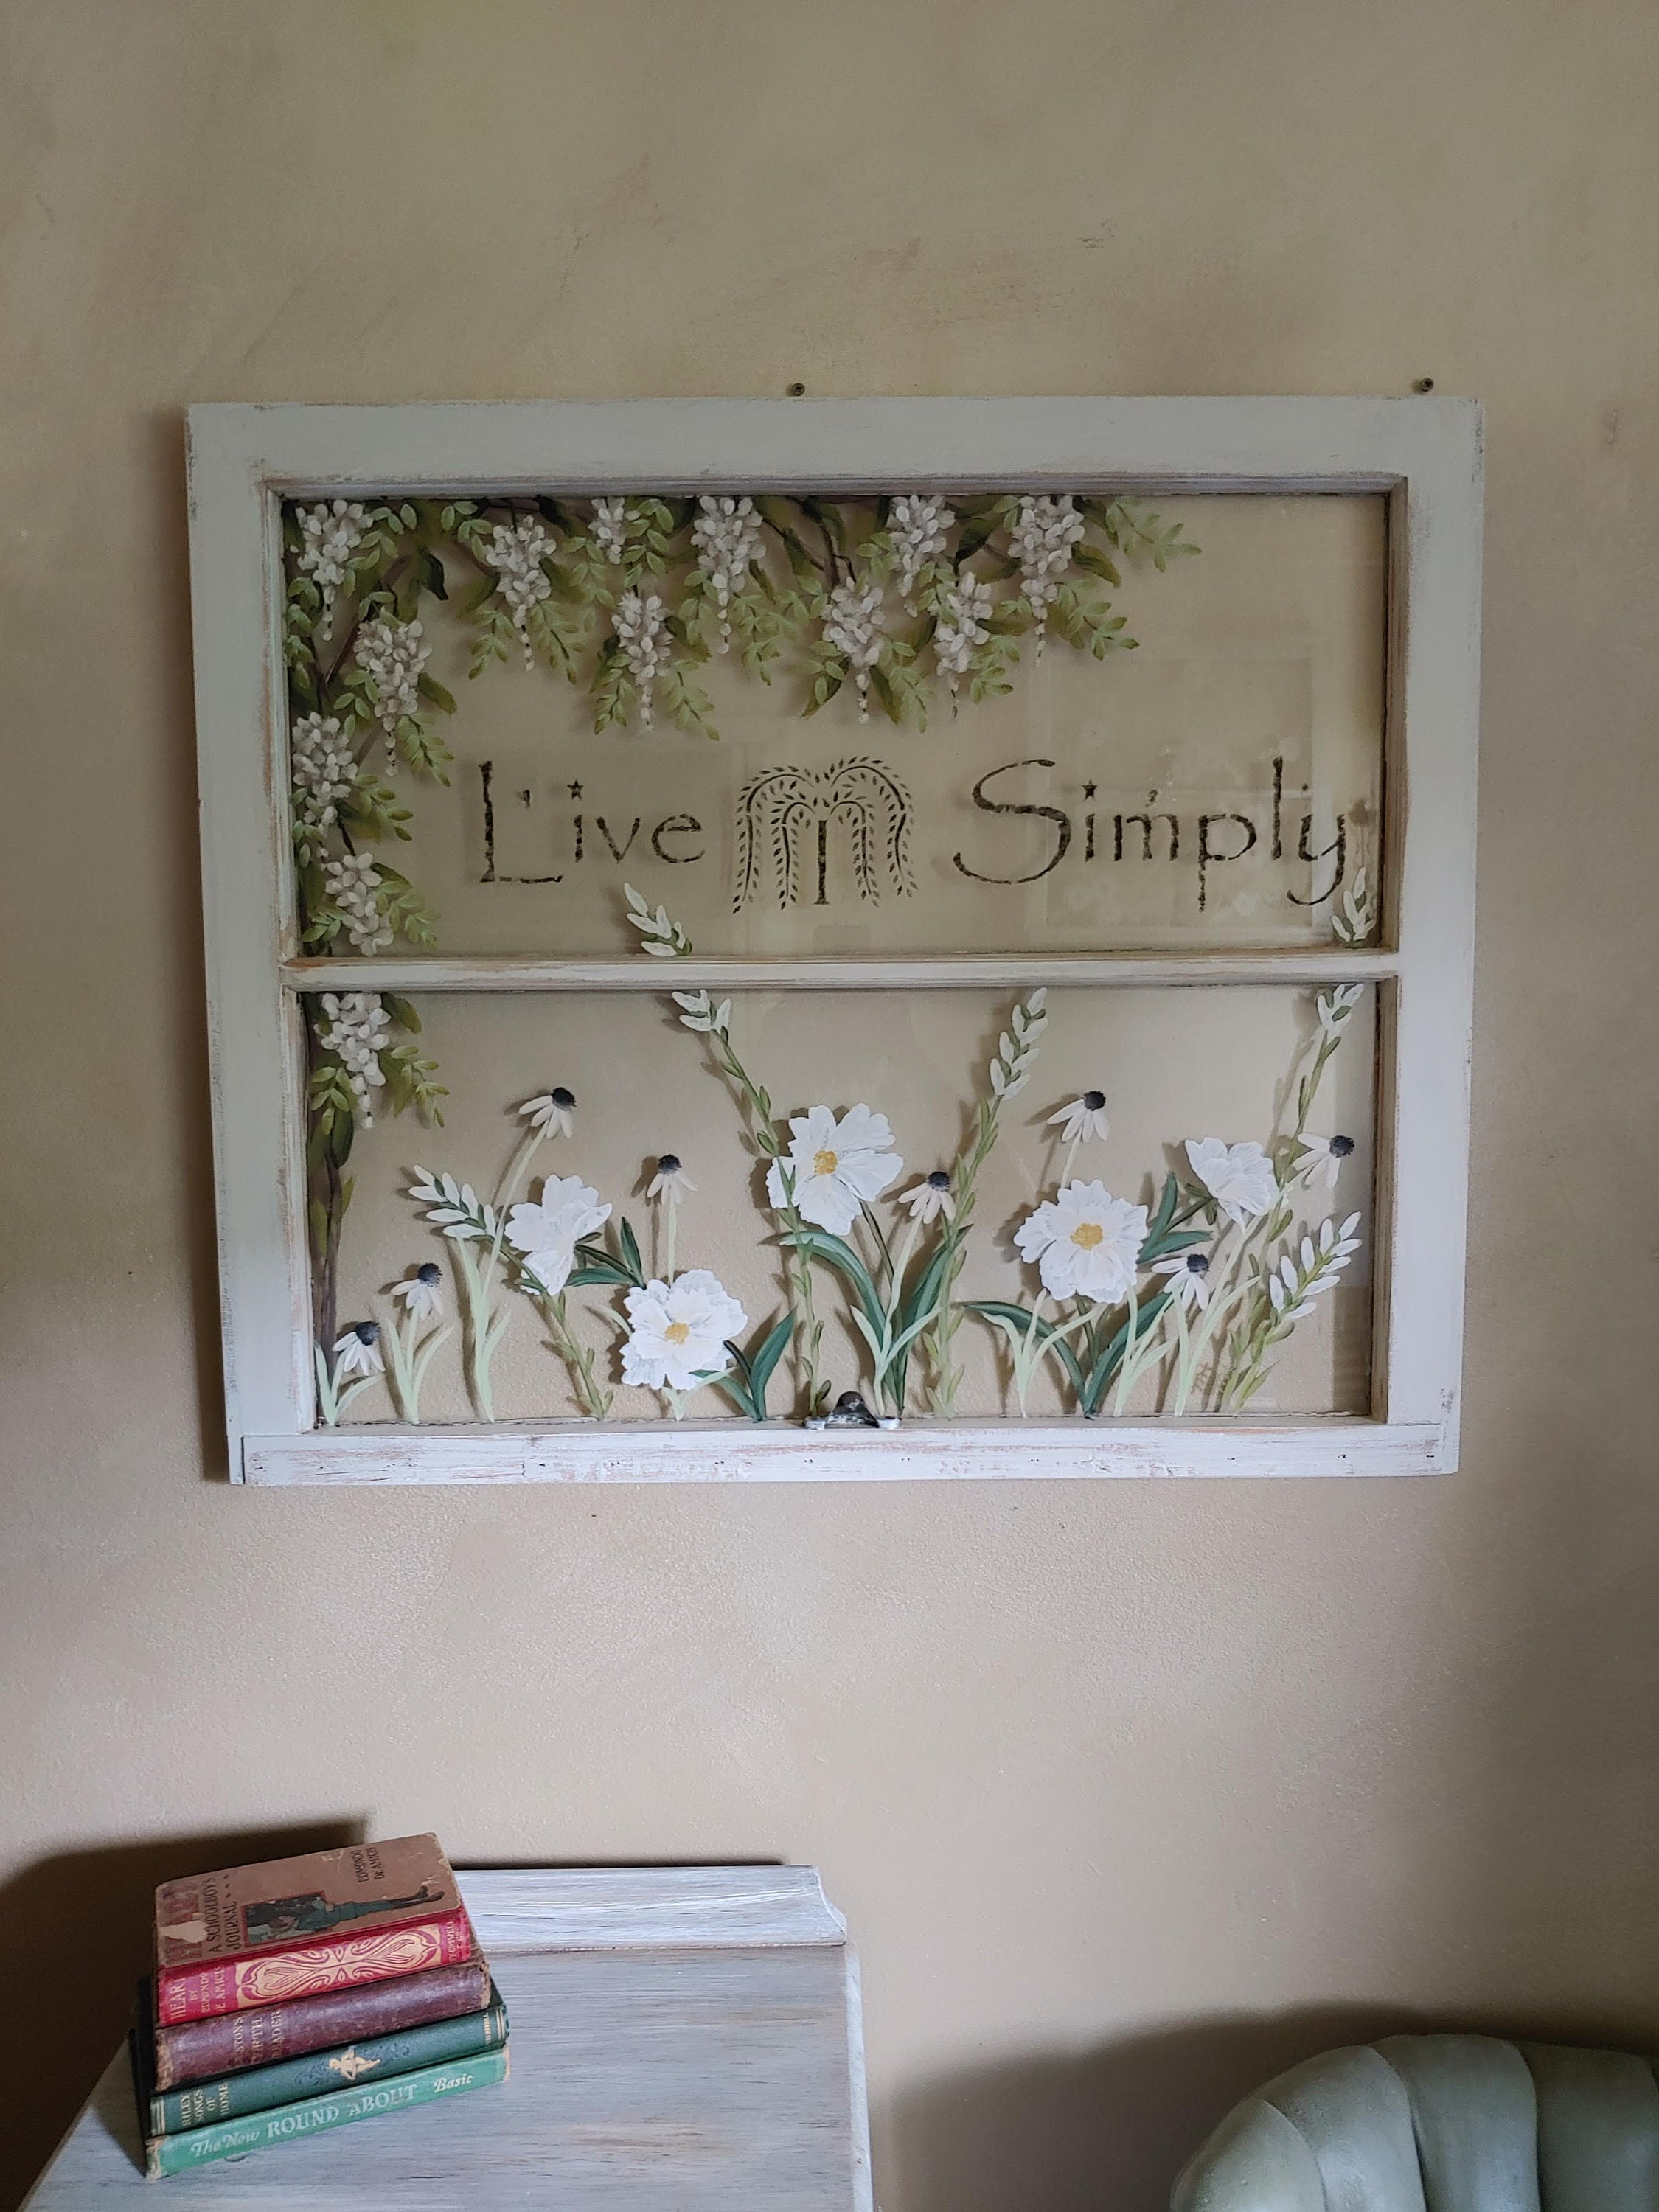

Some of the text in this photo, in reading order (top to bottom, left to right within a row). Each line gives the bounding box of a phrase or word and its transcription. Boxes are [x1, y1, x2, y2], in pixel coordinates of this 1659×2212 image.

[479, 755, 1346, 912] Live Simply
[350, 1849, 369, 1883] EDMONDO
[223, 1901, 242, 1950] JOURNAL
[179, 2094, 192, 2126] RILEY
[190, 2139, 221, 2157] The
[267, 2106, 340, 2138] ROUND
[348, 2084, 418, 2117] ABOUT
[432, 2073, 474, 2093] Basic
[193, 2088, 204, 2123] SONGS
[206, 2097, 216, 2112] OF
[218, 2081, 230, 2117] HOME
